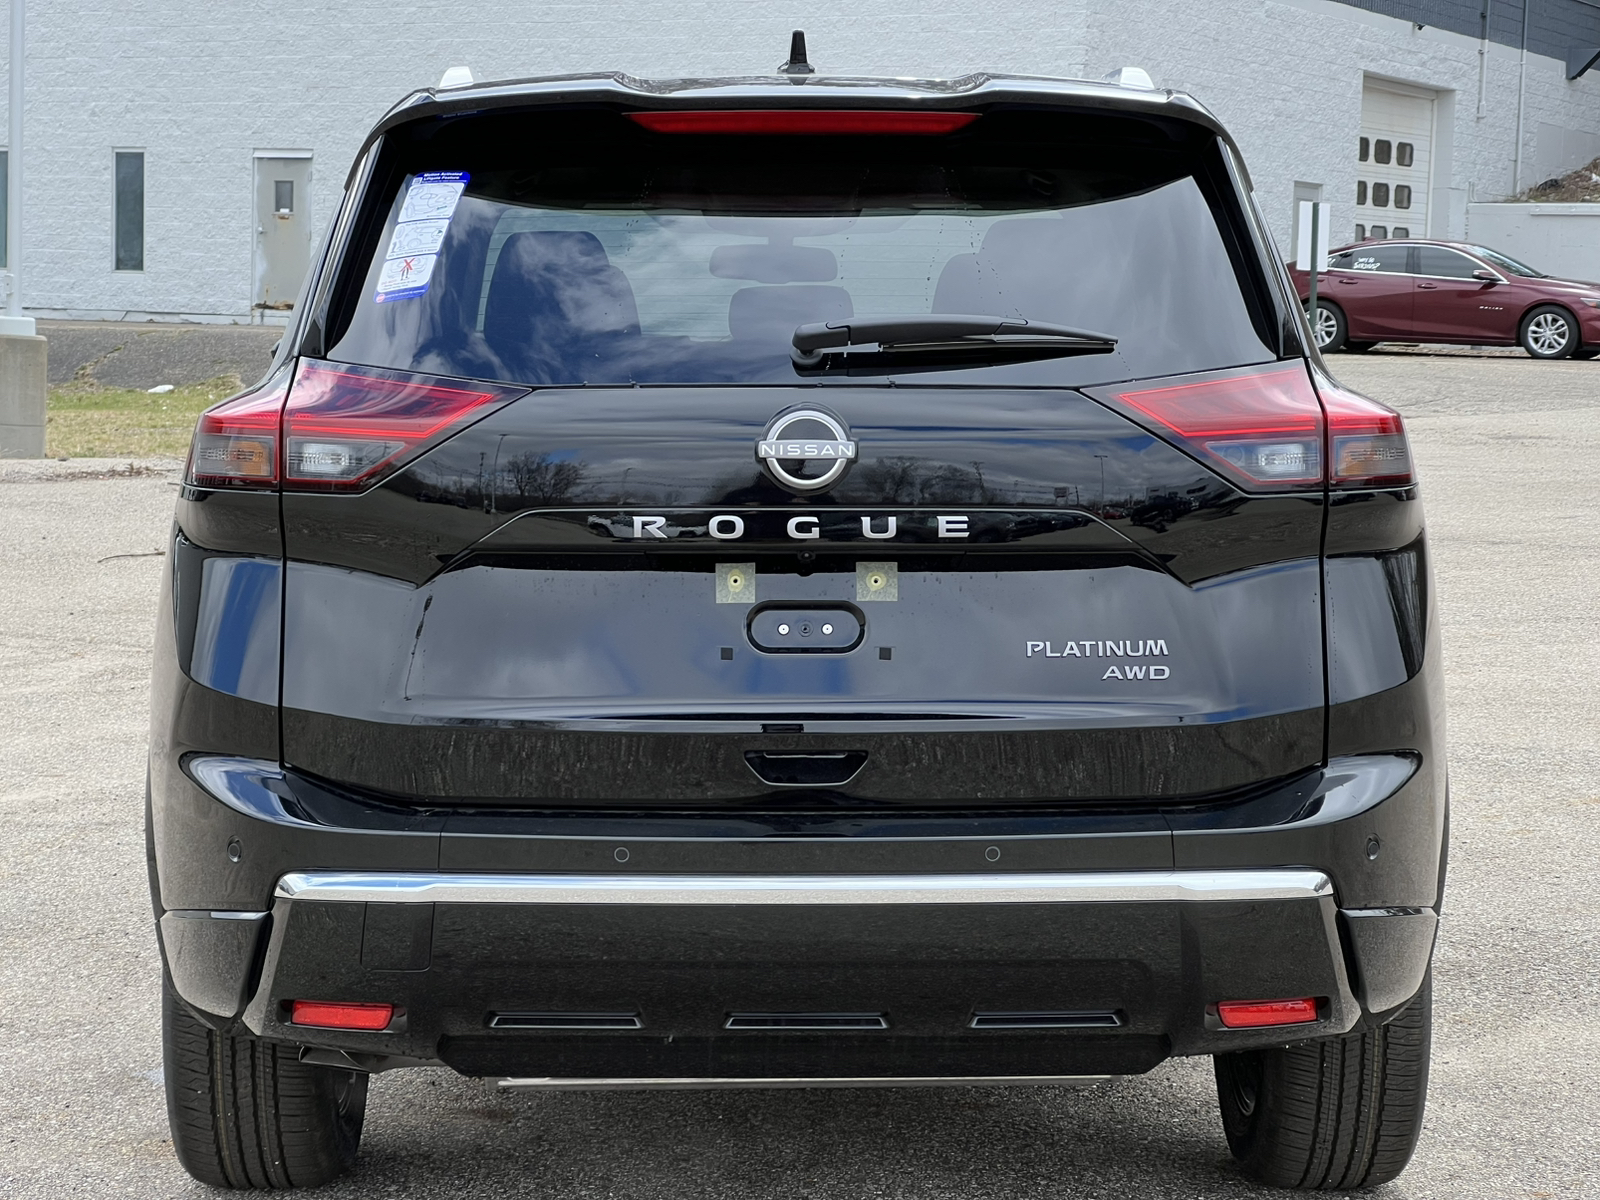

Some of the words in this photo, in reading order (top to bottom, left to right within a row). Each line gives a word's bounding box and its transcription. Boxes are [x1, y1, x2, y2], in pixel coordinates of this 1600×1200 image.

[761, 444, 853, 456] NISSAN
[632, 514, 971, 540] ROGUE
[1026, 639, 1170, 658] PLATINUM
[1101, 665, 1171, 681] AWD
